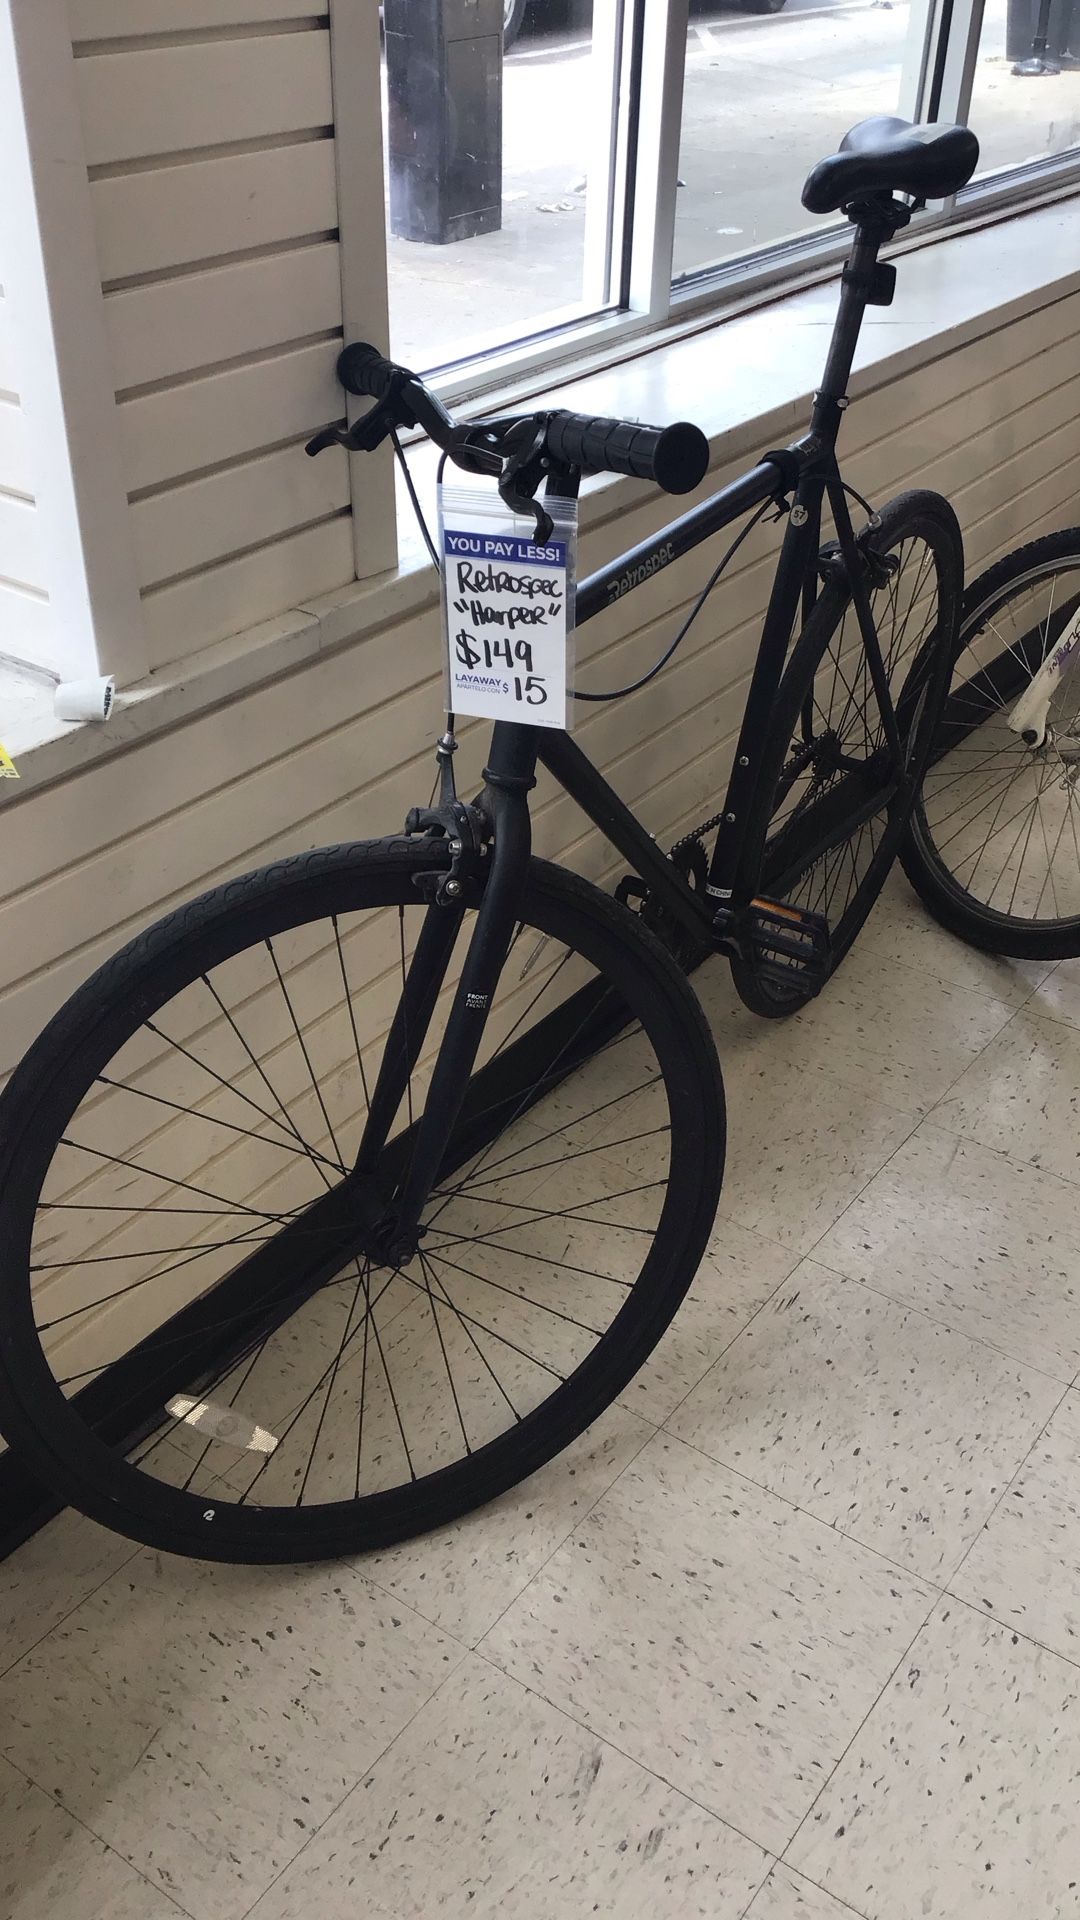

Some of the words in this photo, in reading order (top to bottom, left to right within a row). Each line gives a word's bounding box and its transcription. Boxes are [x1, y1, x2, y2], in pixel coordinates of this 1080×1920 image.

[794, 509, 805, 520] 57
[448, 536, 481, 552] YOU
[485, 541, 515, 557] PAY
[517, 544, 560, 562] LESS!
[606, 542, 675, 602] Retrospec
[455, 628, 533, 673] $149
[455, 673, 501, 687] LAYAWAY
[502, 682, 510, 694] $
[514, 676, 548, 705] 15
